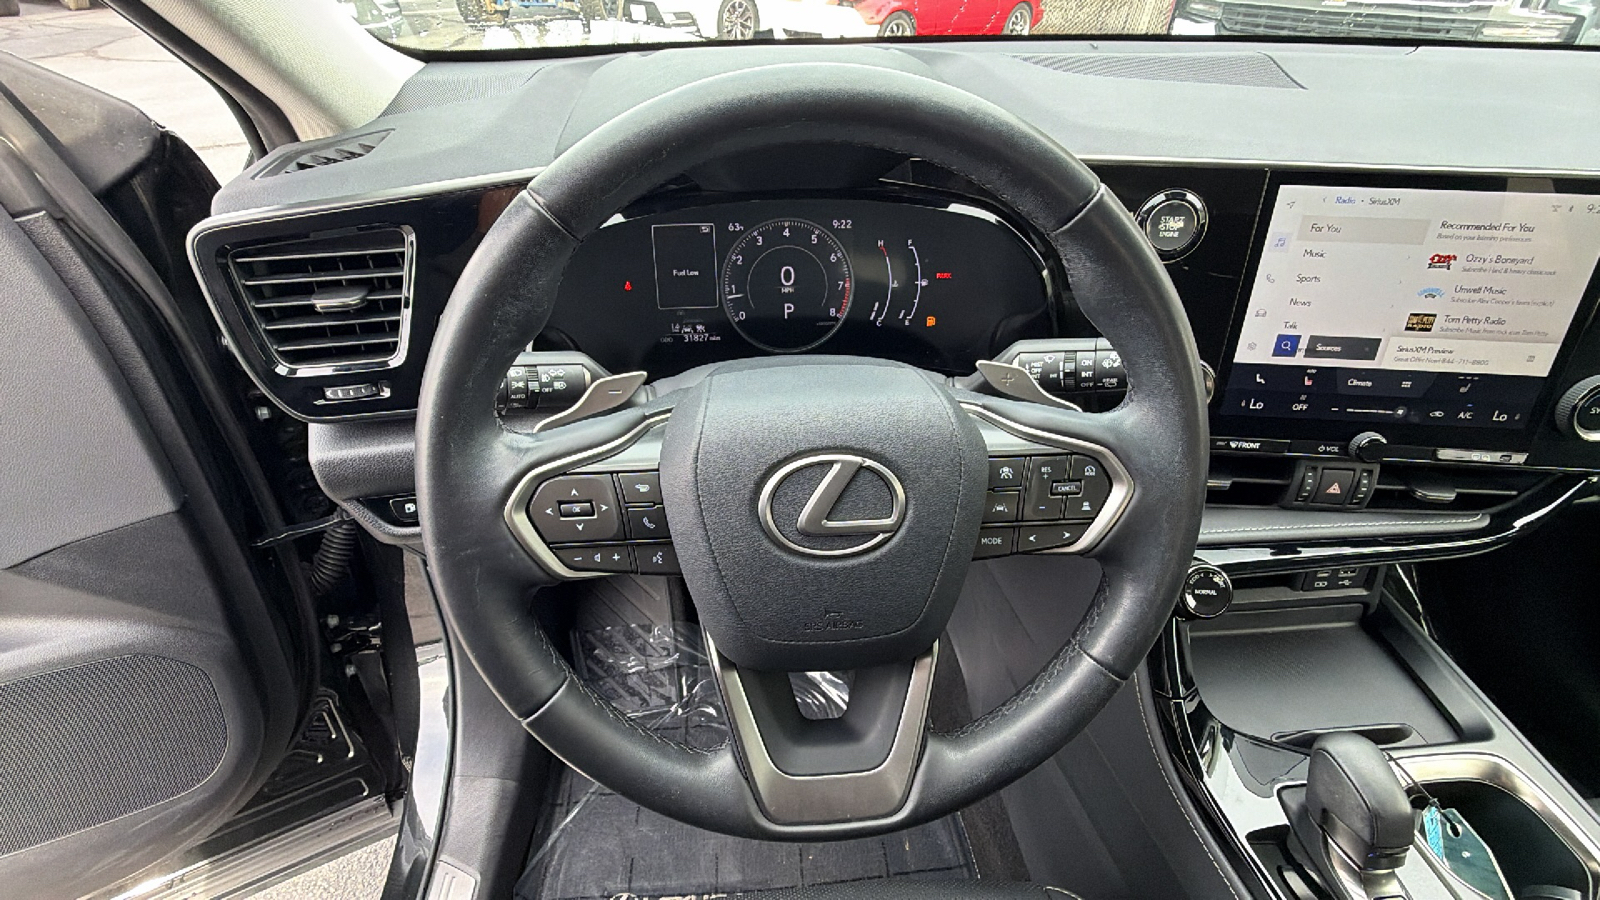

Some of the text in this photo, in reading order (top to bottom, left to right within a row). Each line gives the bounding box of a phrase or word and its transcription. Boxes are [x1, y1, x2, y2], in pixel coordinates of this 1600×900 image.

[1335, 196, 1401, 206] Radio SiriusXM
[832, 219, 853, 229] 9:22
[1159, 223, 1179, 231] STOP
[1310, 223, 1342, 234] For You
[1440, 220, 1535, 233] Recommended For You
[783, 228, 790, 237] 4
[757, 236, 763, 246] 3
[811, 234, 818, 244] 5
[830, 253, 837, 262] 6
[1303, 249, 1327, 258] Music
[736, 255, 743, 265] 2
[1466, 254, 1535, 265] Ozzy's Boneyard
[780, 266, 795, 286] 0
[1296, 274, 1321, 283] Sports
[731, 284, 736, 294] 1
[838, 281, 844, 290] 7
[1483, 286, 1508, 295] Music
[1289, 298, 1312, 307] News
[739, 311, 746, 320] 0
[784, 303, 794, 319] P
[829, 307, 836, 317] 8
[1444, 315, 1461, 323] Tom
[1462, 316, 1482, 325] Petty
[1483, 317, 1506, 325] Radio
[1284, 321, 1298, 330] Talk
[683, 333, 709, 342] 31827
[1316, 343, 1342, 352] Sources
[1347, 378, 1373, 387] Climate
[1250, 398, 1264, 410] Lo
[1292, 403, 1309, 411] OFF
[1457, 411, 1474, 420] A/C
[1492, 410, 1508, 422] Lo
[981, 537, 1002, 545] MODE
[804, 620, 864, 632] SRS AIRBAG
